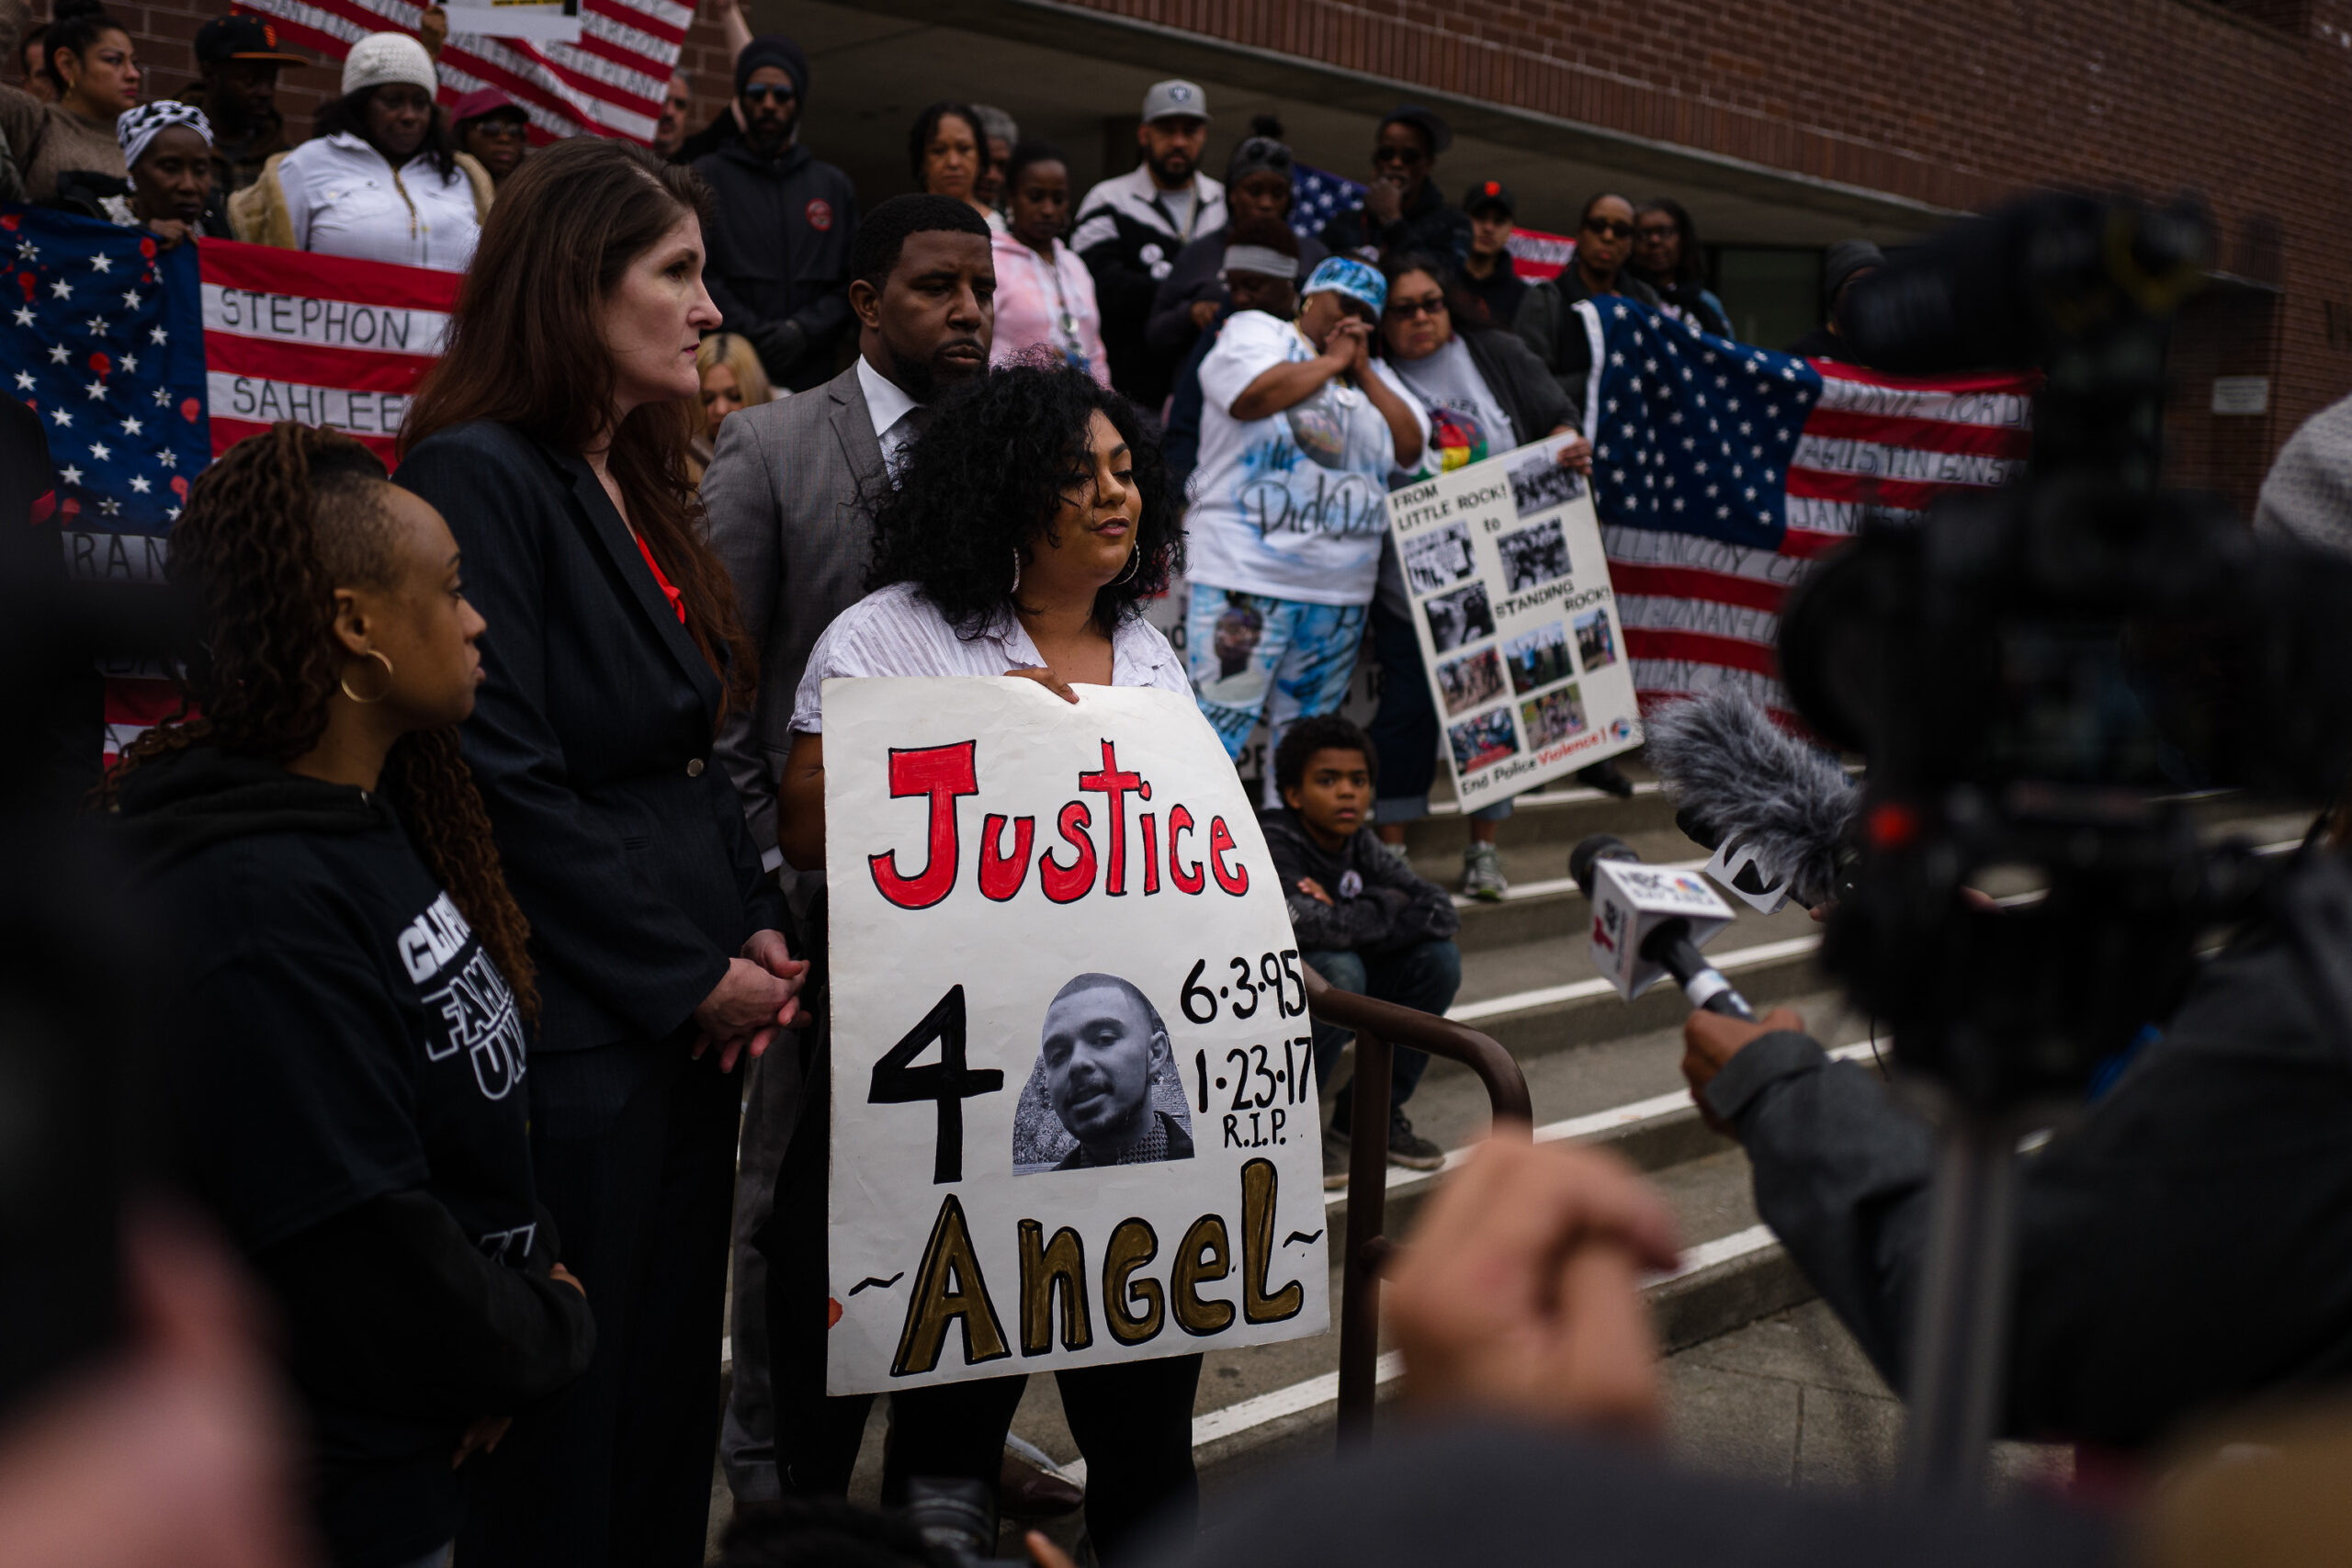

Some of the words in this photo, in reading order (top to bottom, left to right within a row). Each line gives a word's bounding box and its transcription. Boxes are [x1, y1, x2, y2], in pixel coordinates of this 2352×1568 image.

[220, 287, 411, 350] STEPHON
[1393, 483, 1439, 509] FROM
[1397, 500, 1453, 531] LITTLE
[1457, 482, 1507, 509] ROCK!
[1484, 516, 1501, 533] to
[1495, 579, 1574, 618] STANDING
[1461, 775, 1489, 796] End
[1494, 758, 1538, 783] Police
[867, 738, 1250, 910] Justice
[867, 984, 1004, 1185] 4
[1224, 1109, 1287, 1148] R.I.P.
